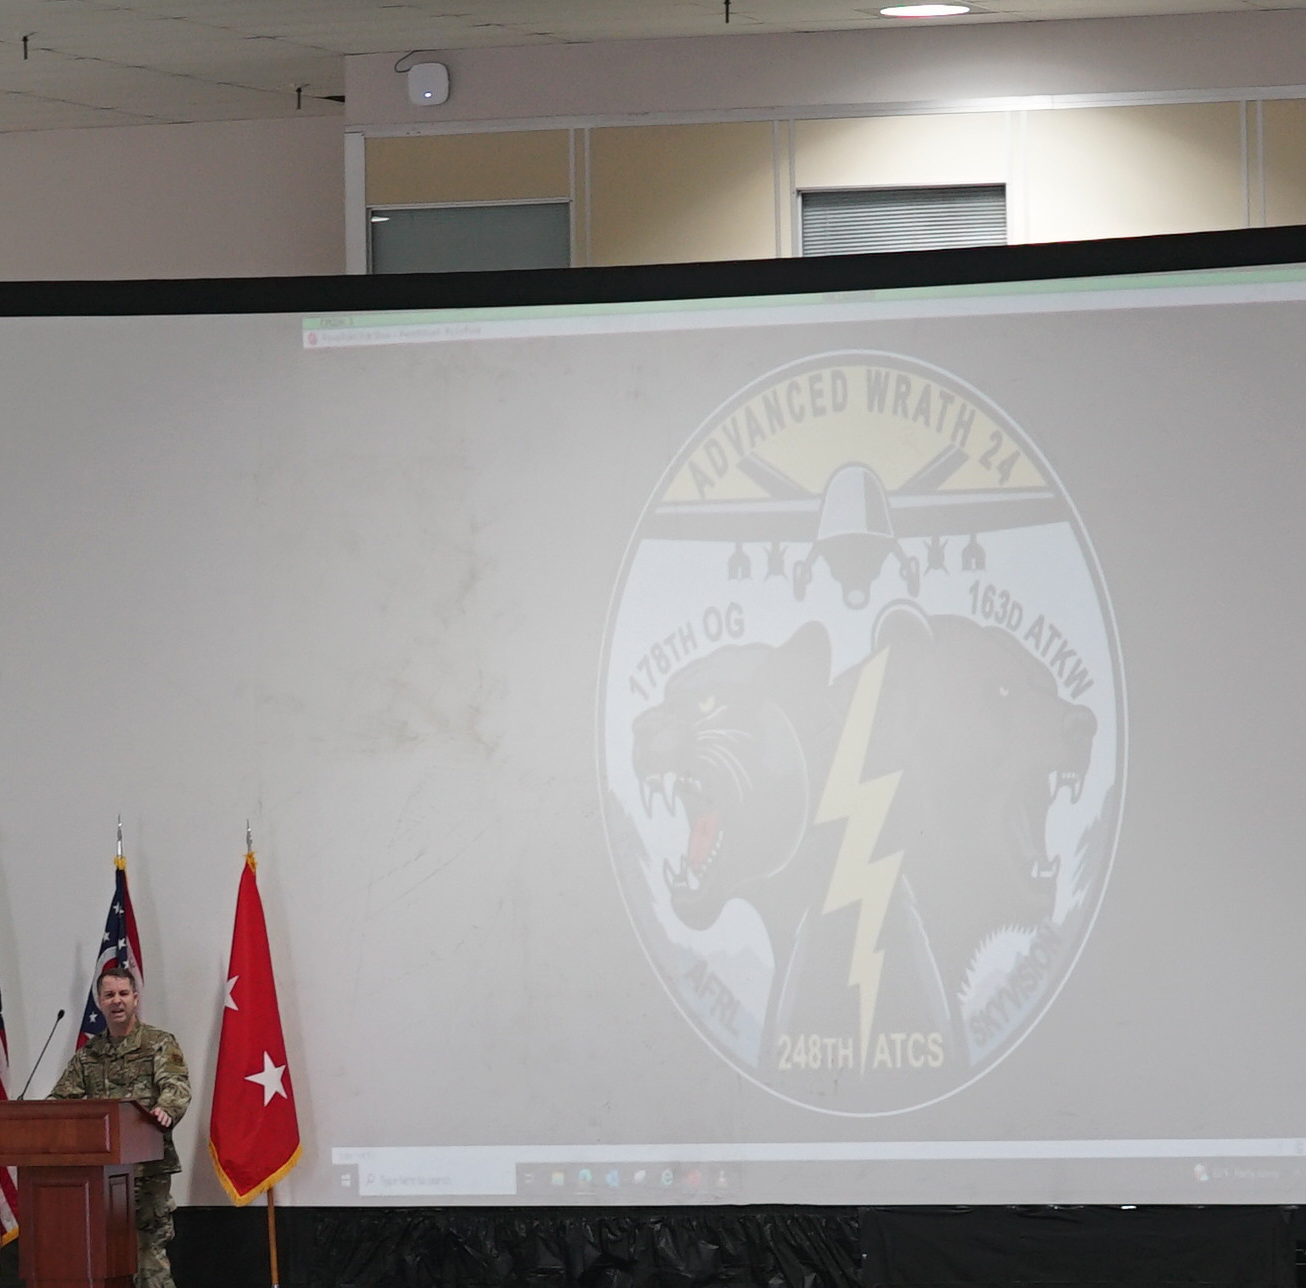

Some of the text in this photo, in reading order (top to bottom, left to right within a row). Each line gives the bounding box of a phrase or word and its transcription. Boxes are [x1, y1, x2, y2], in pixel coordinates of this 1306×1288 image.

[688, 368, 1021, 499] ADVANCED WRATH 24
[628, 603, 746, 700] 178TH OG
[968, 580, 1095, 699] 163D ATKW
[778, 1032, 944, 1070] 248TH ATCS
